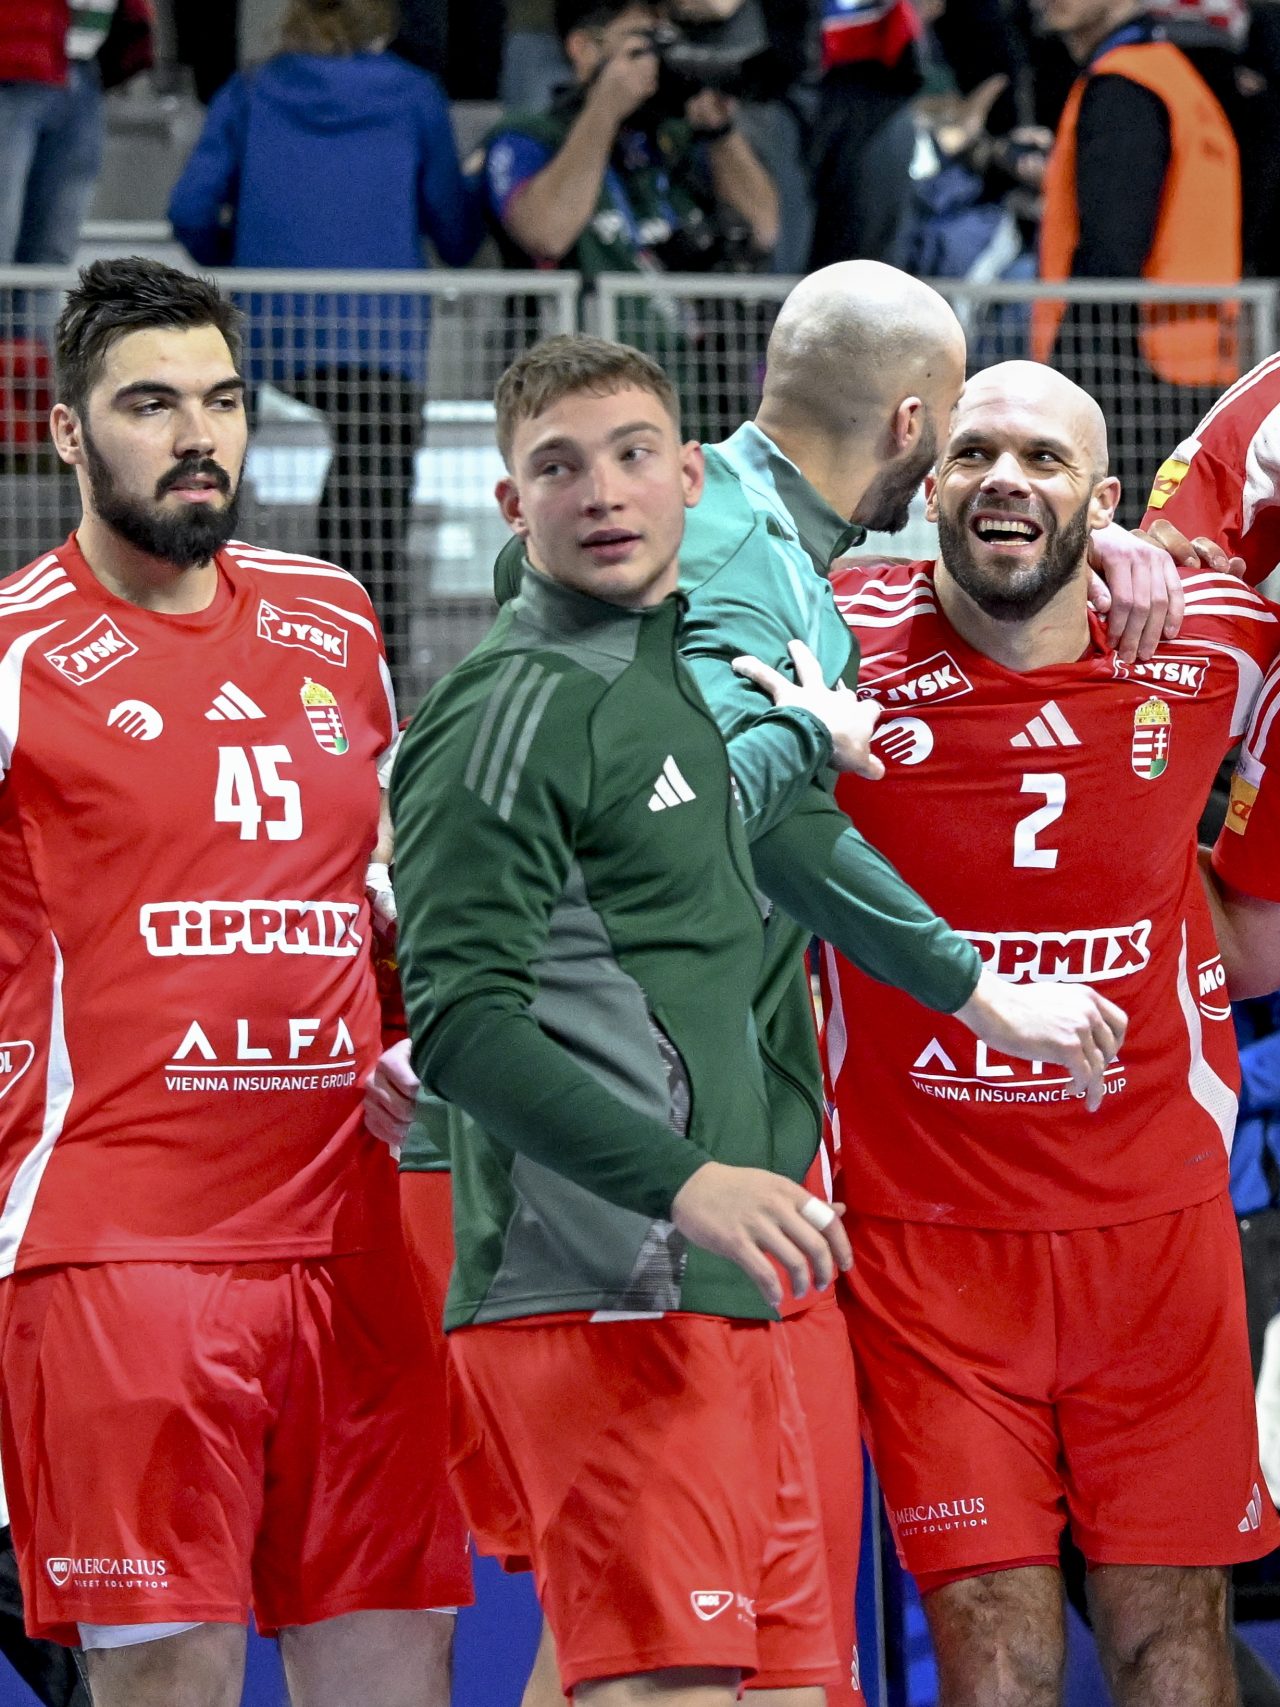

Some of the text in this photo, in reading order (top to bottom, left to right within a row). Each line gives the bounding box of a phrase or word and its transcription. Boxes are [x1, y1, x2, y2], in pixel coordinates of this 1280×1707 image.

[76, 630, 127, 673] JYSK
[278, 621, 344, 657] JYSK
[887, 664, 962, 701] JYSK
[1134, 662, 1201, 687] JYSK
[214, 744, 303, 841] 45
[1013, 773, 1067, 869] 2
[1199, 964, 1226, 997] MO
[172, 1017, 355, 1060] ALFA
[165, 1072, 356, 1091] VIENNA INSURANCE GROUP
[912, 1079, 971, 1102] VIENNA
[975, 1088, 1070, 1103] INSURANCE
[923, 1517, 988, 1534] SOLUTION
[72, 1558, 166, 1576] MERCARIUS
[105, 1580, 169, 1589] SOLUTION
